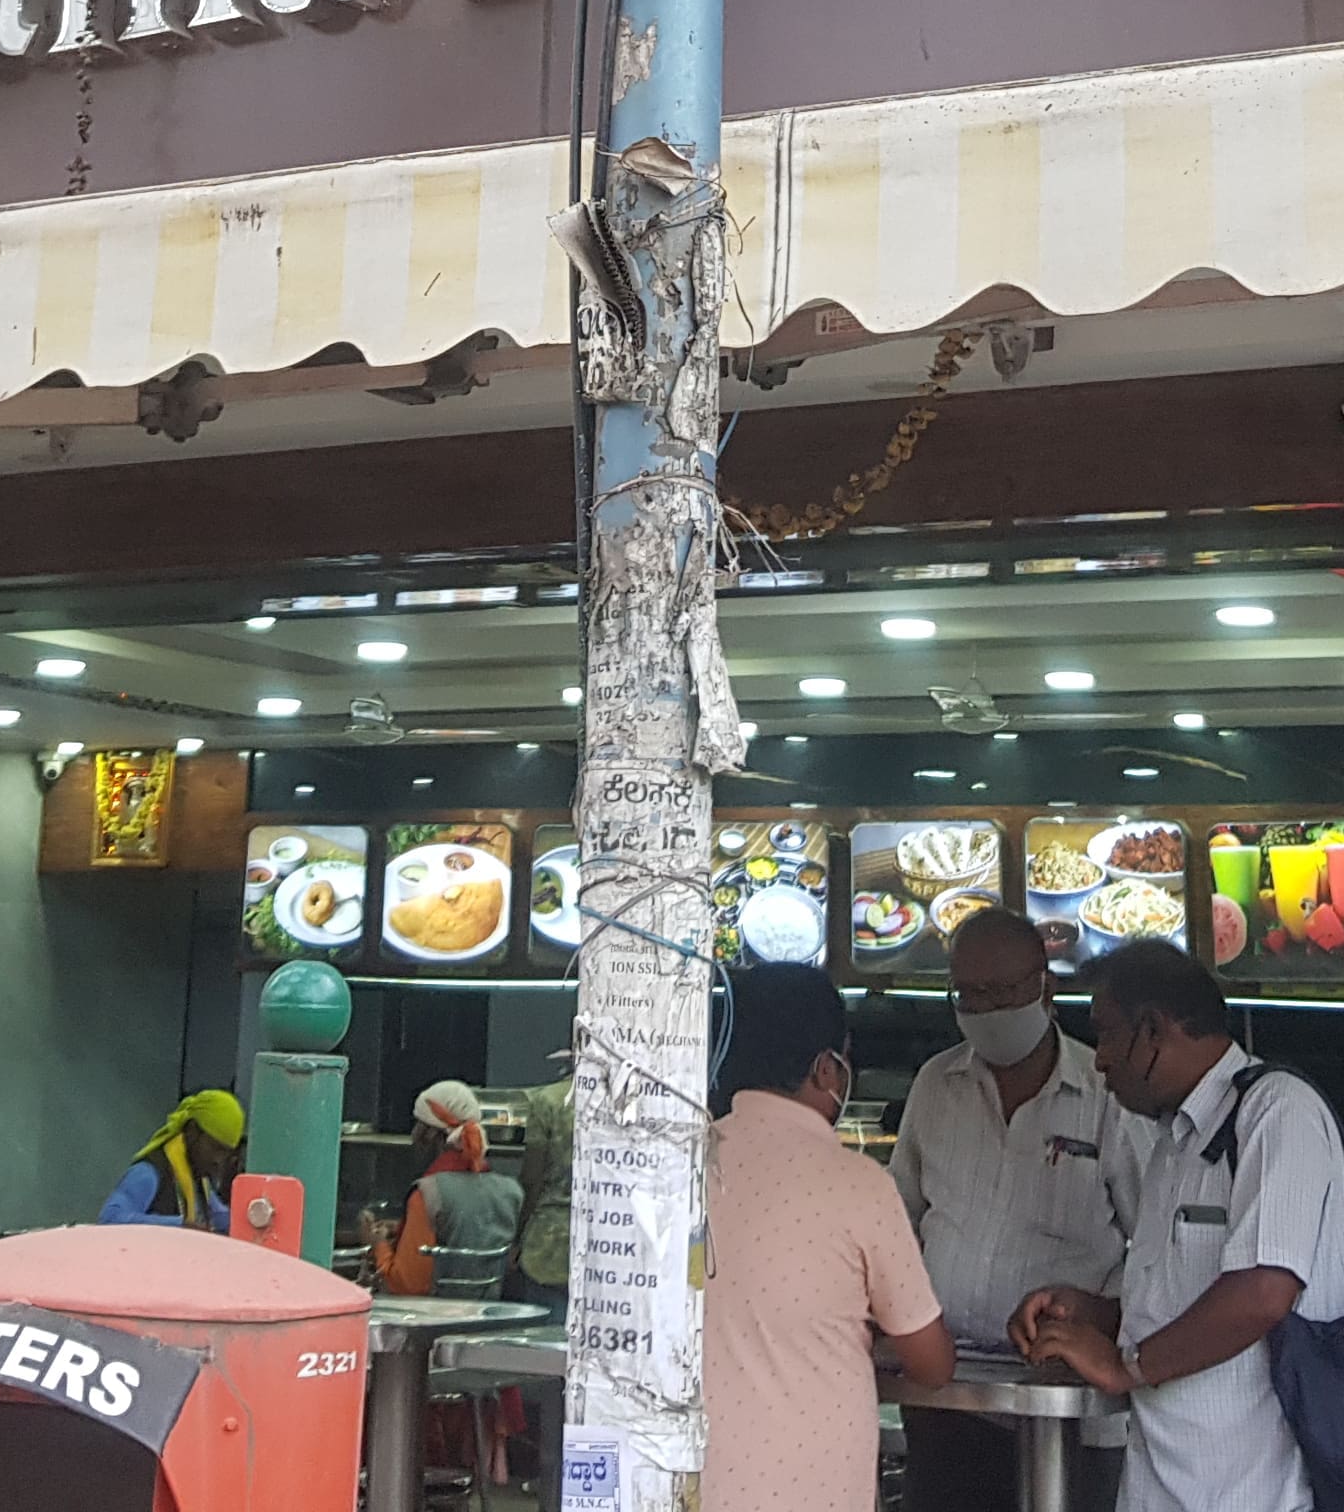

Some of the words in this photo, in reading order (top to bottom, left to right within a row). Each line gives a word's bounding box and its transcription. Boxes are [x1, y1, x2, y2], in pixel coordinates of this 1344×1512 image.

[599, 1211, 634, 1226] JOB
[622, 1273, 658, 1289] JOB
[296, 1350, 357, 1379] 2321
